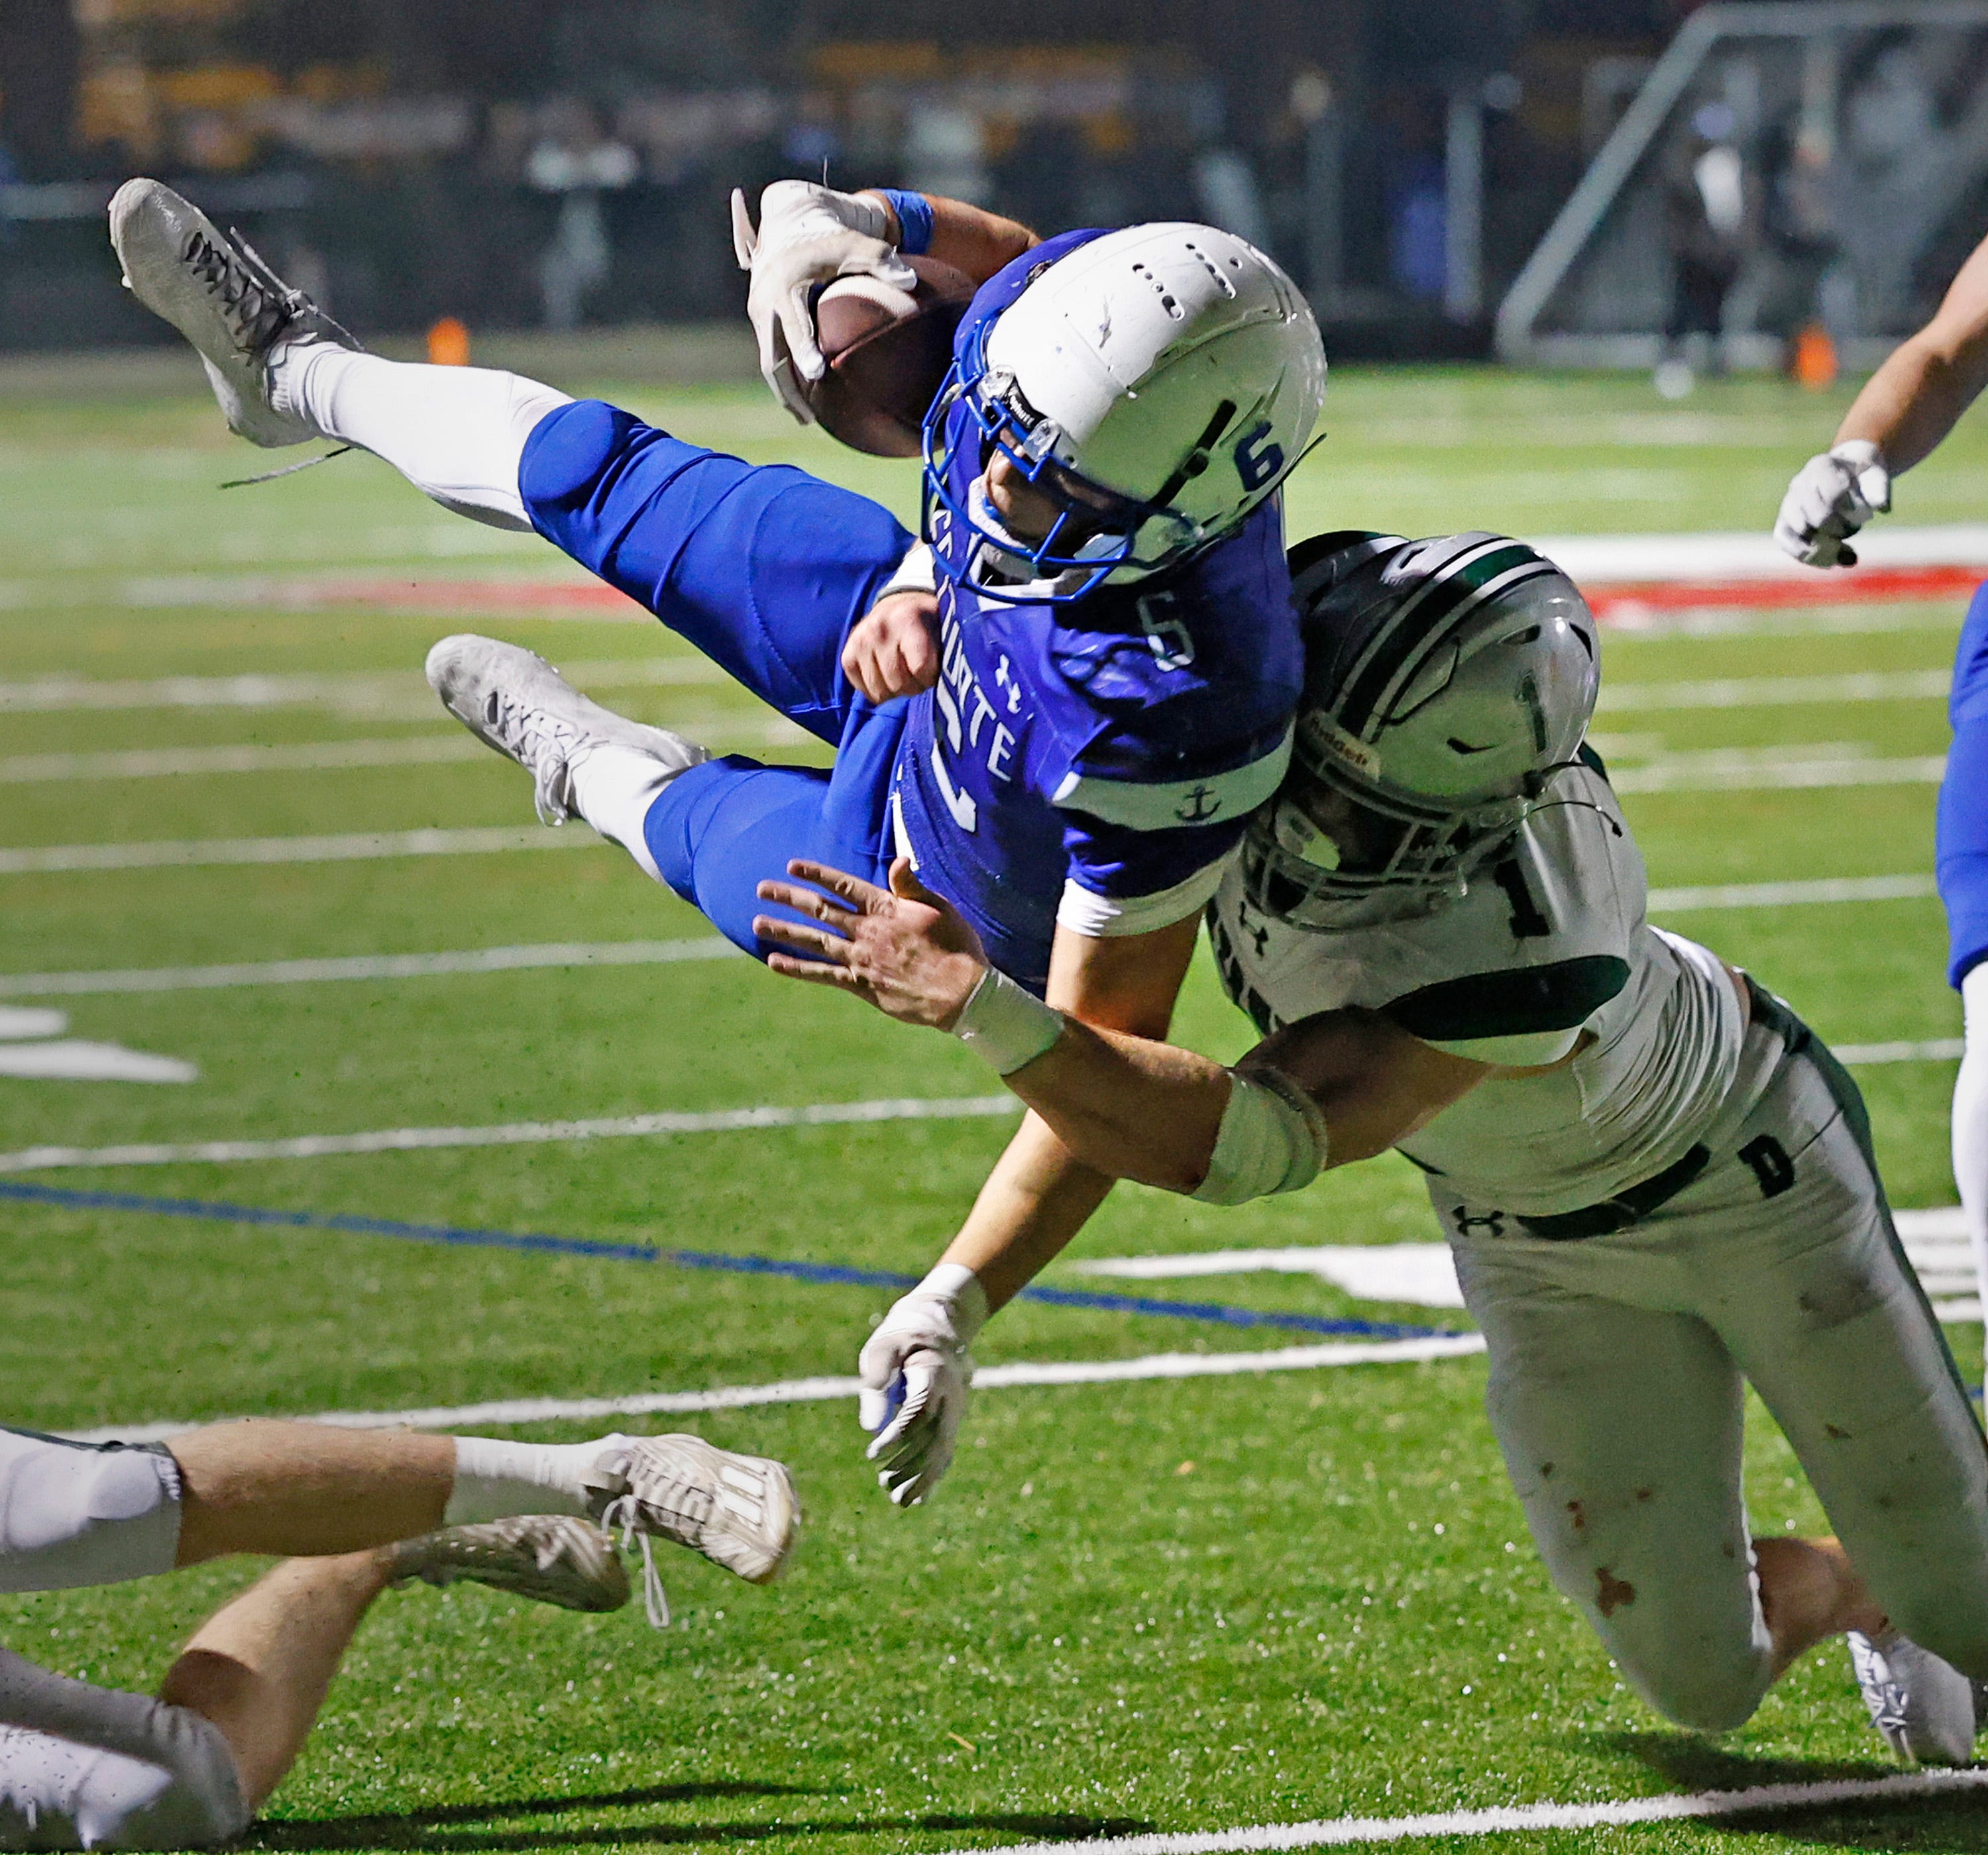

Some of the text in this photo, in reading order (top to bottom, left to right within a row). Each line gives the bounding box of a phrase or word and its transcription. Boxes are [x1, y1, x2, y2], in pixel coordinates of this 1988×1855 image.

[1233, 419, 1284, 492] 6
[1136, 590, 1195, 672] 6
[1494, 859, 1551, 938] 1
[1738, 1134, 1795, 1198] D
